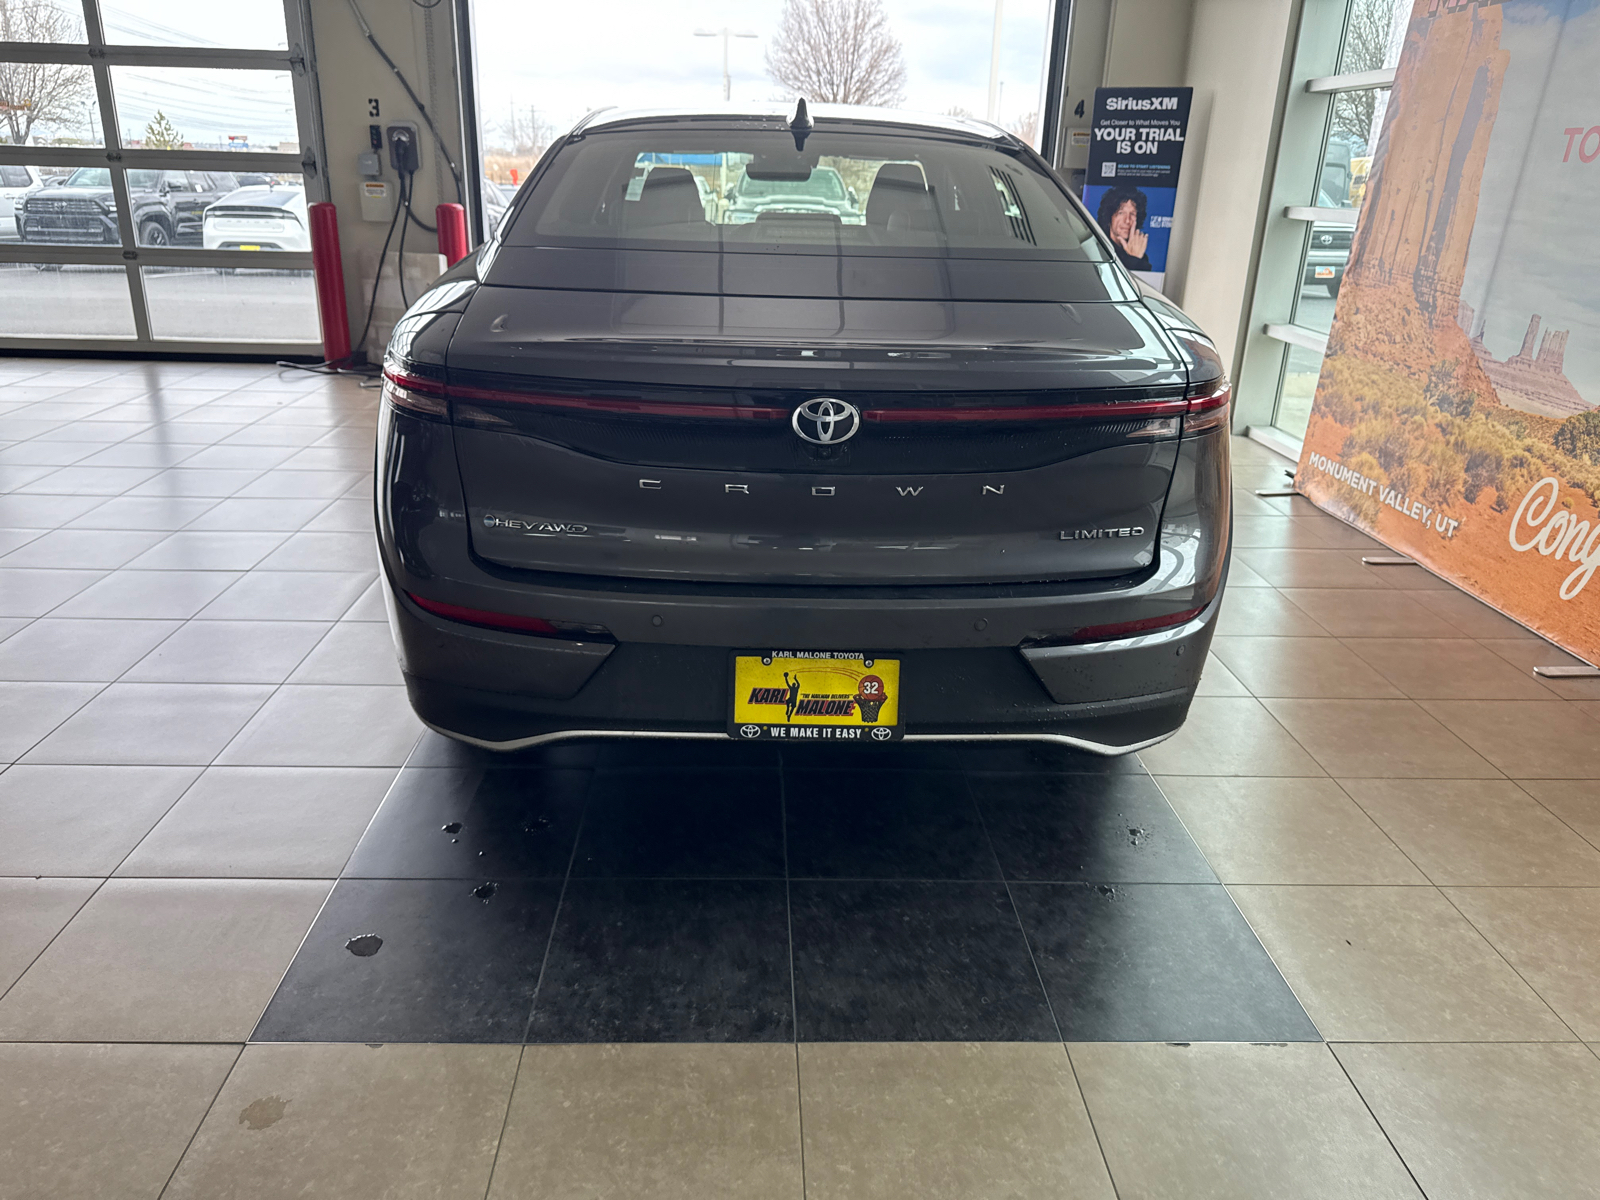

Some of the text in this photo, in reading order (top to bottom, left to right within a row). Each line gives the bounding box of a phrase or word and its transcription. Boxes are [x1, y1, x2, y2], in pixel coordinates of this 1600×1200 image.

[368, 98, 380, 117] 3
[1074, 99, 1085, 118] 4
[1106, 97, 1178, 110] SiriusXM
[1094, 128, 1137, 141] YOUR
[1139, 128, 1184, 142] TRIAL
[1116, 141, 1158, 154] IS ON
[638, 478, 1005, 497] CROWN
[1308, 451, 1459, 538] MONUMENT VALLEY, UT
[1059, 525, 1145, 541] LIMITED
[771, 650, 865, 660] KARL MALONE TOYOTA
[748, 687, 788, 704] KARL
[863, 681, 879, 694] 32
[795, 699, 855, 716] MALONE
[770, 726, 862, 739] WE MAKE IT EASY
